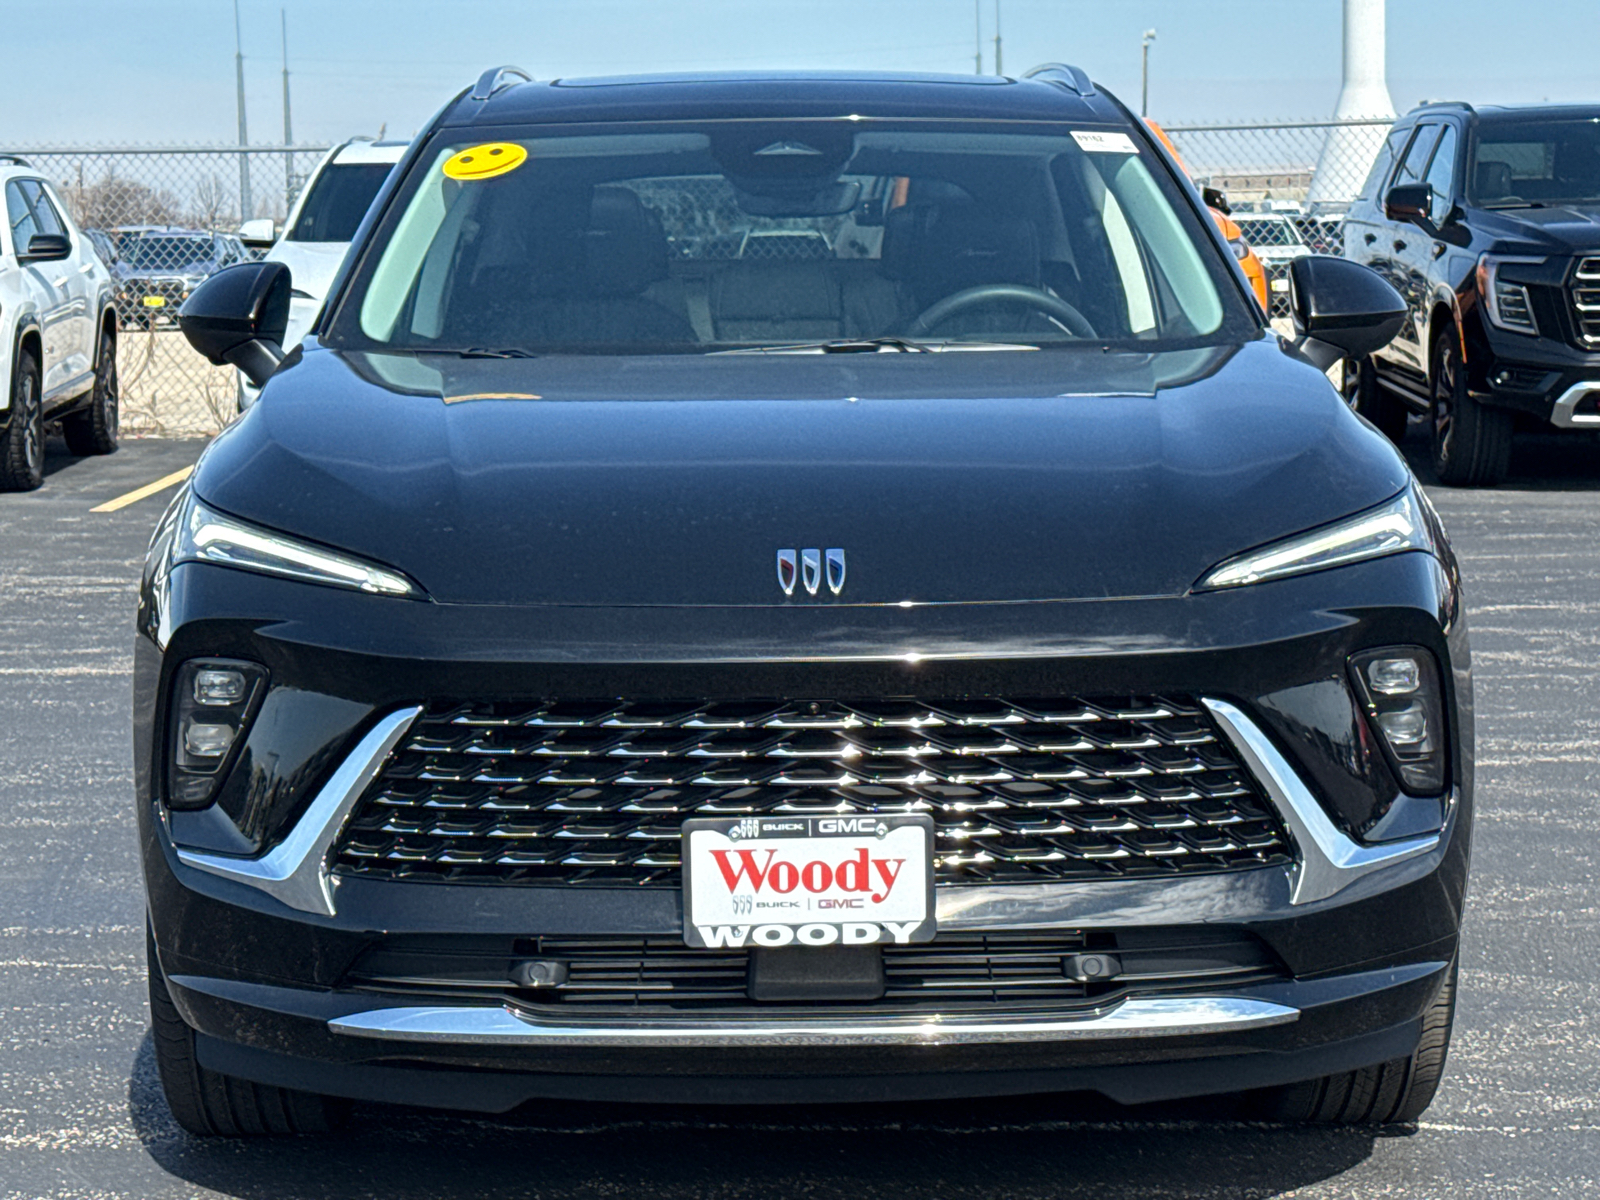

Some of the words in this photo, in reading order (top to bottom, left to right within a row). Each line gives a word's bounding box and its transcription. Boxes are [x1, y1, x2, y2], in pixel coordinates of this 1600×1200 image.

[762, 823, 804, 831] BUICK
[818, 819, 876, 833] GMC
[709, 848, 906, 904] Woody
[818, 898, 865, 909] GMC
[698, 921, 922, 948] WOODY
